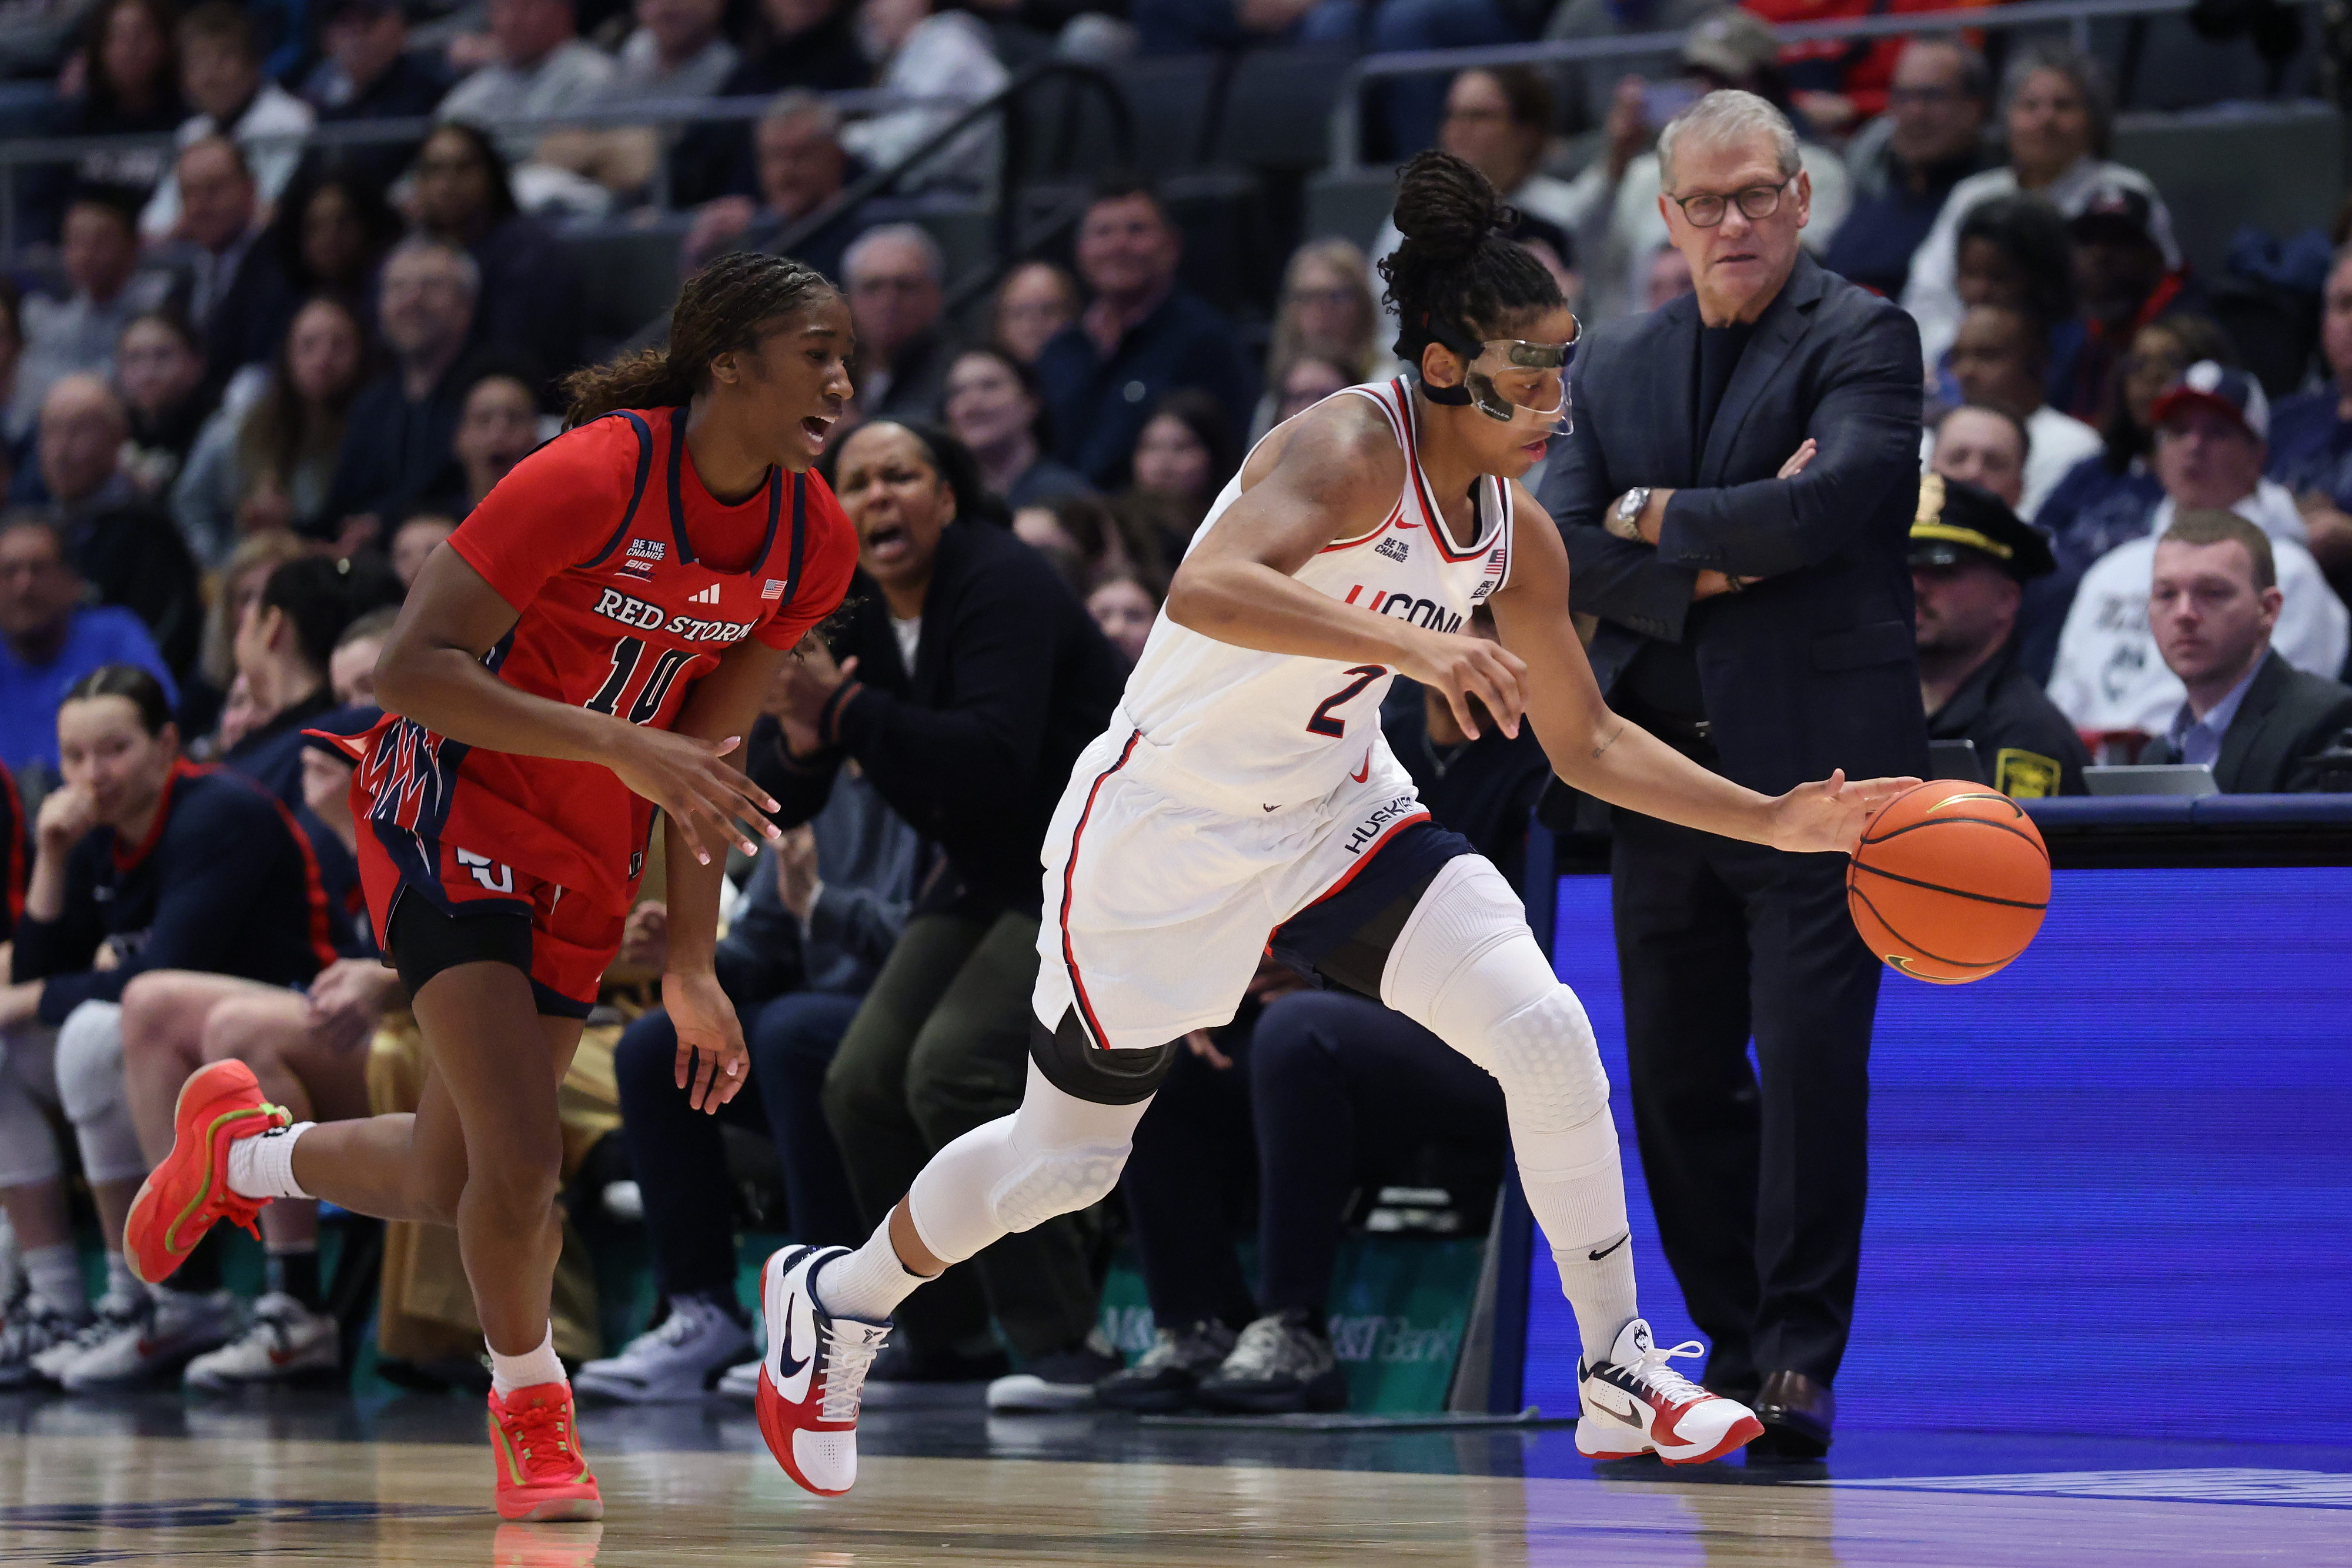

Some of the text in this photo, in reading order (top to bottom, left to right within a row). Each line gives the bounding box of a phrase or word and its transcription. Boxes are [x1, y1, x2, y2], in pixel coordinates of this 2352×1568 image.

[626, 547, 664, 561] CHANGE
[632, 539, 666, 553] BE THE
[1374, 544, 1408, 563] CHANGE
[1383, 537, 1409, 554] BE THE
[624, 559, 653, 571] BIG
[593, 587, 759, 643] RED STORM
[584, 636, 701, 725] 10
[1306, 664, 1388, 738] 2
